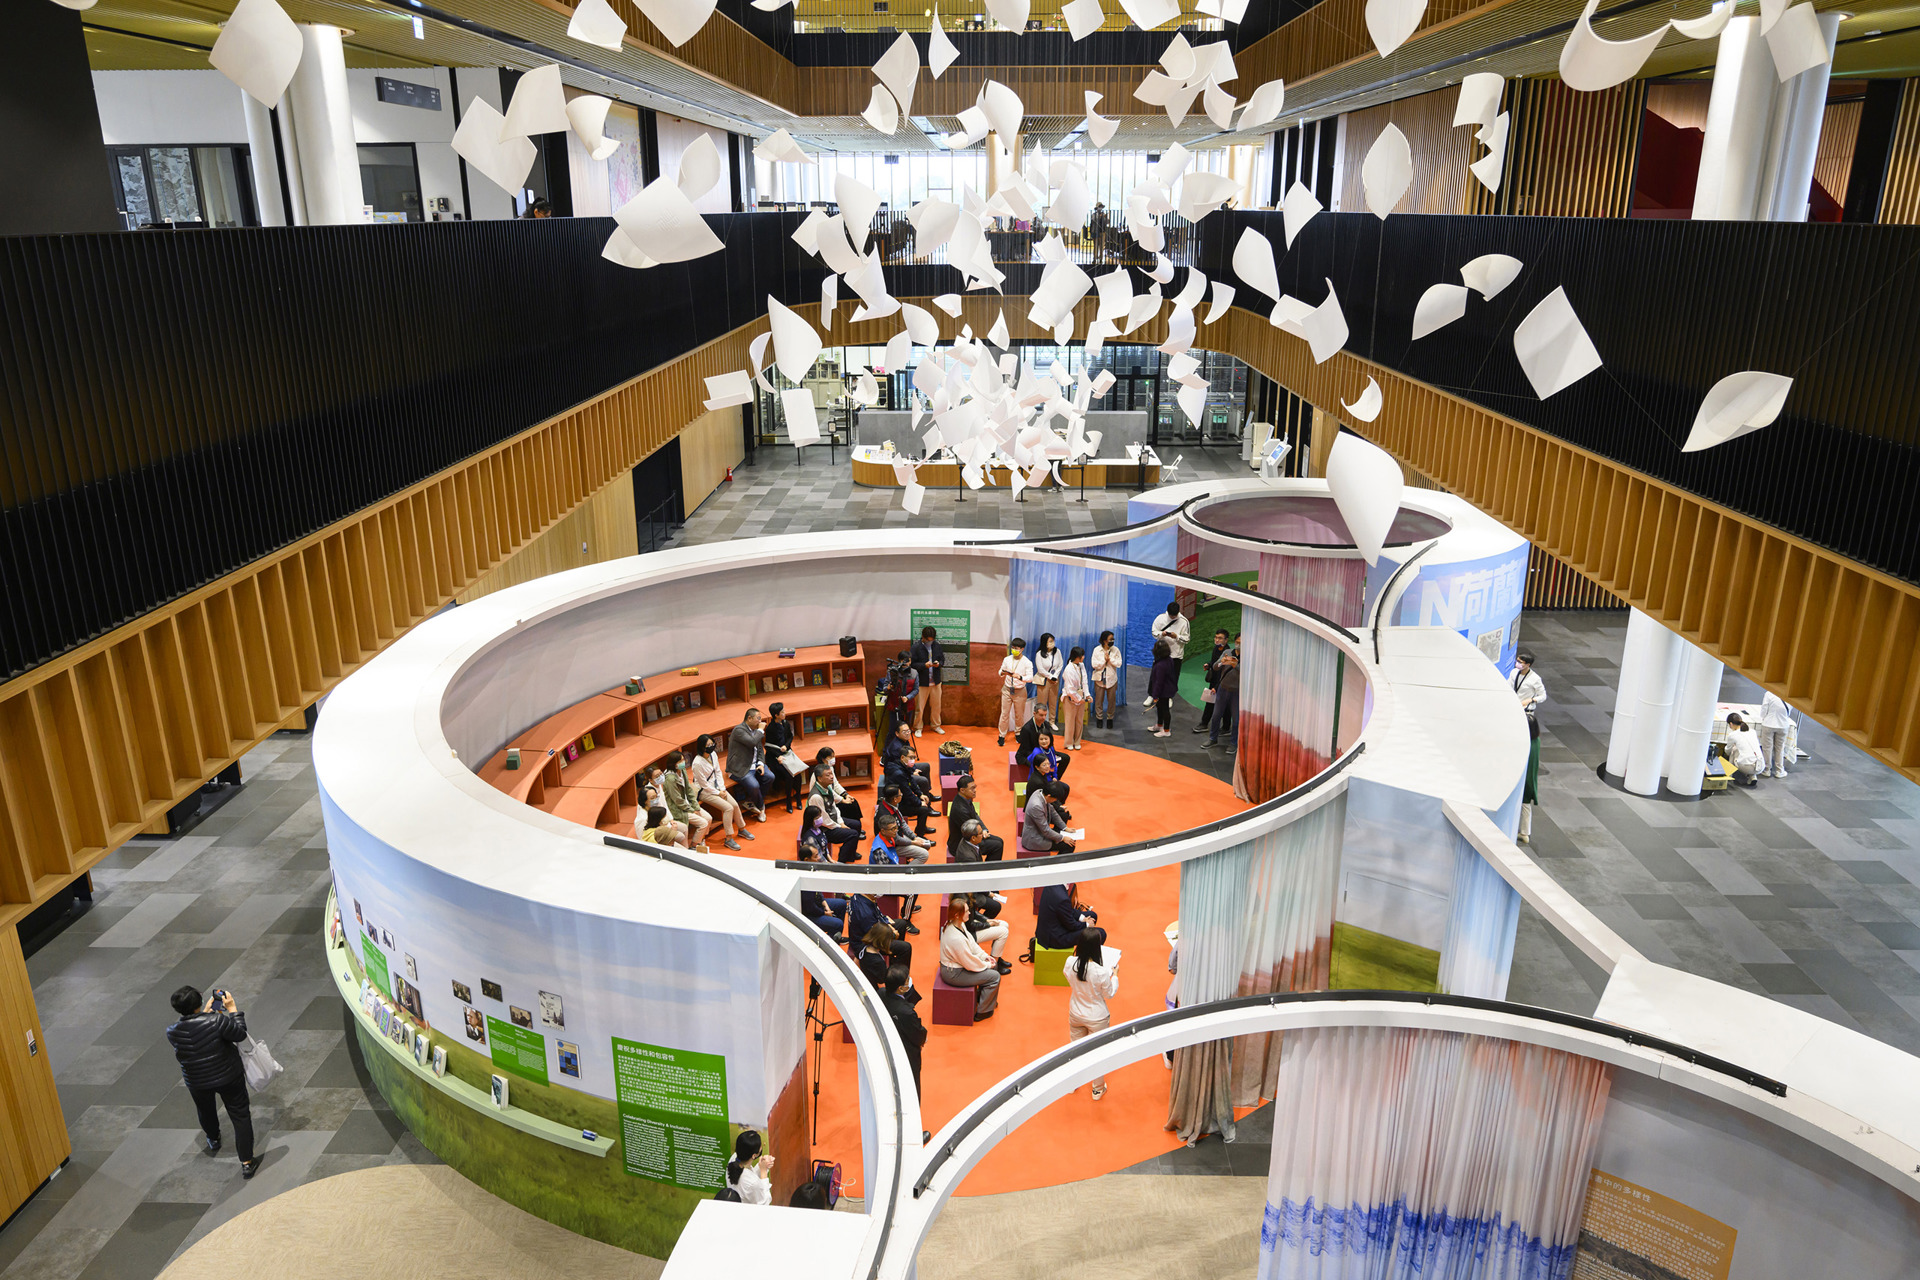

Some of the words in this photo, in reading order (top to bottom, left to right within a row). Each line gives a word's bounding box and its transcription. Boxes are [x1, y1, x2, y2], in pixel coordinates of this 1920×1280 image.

[622, 1113, 647, 1124] Celebrating
[647, 1119, 665, 1127] Diversity
[669, 1123, 692, 1132] Inclusivity
[1602, 1261, 1632, 1278] Children's
